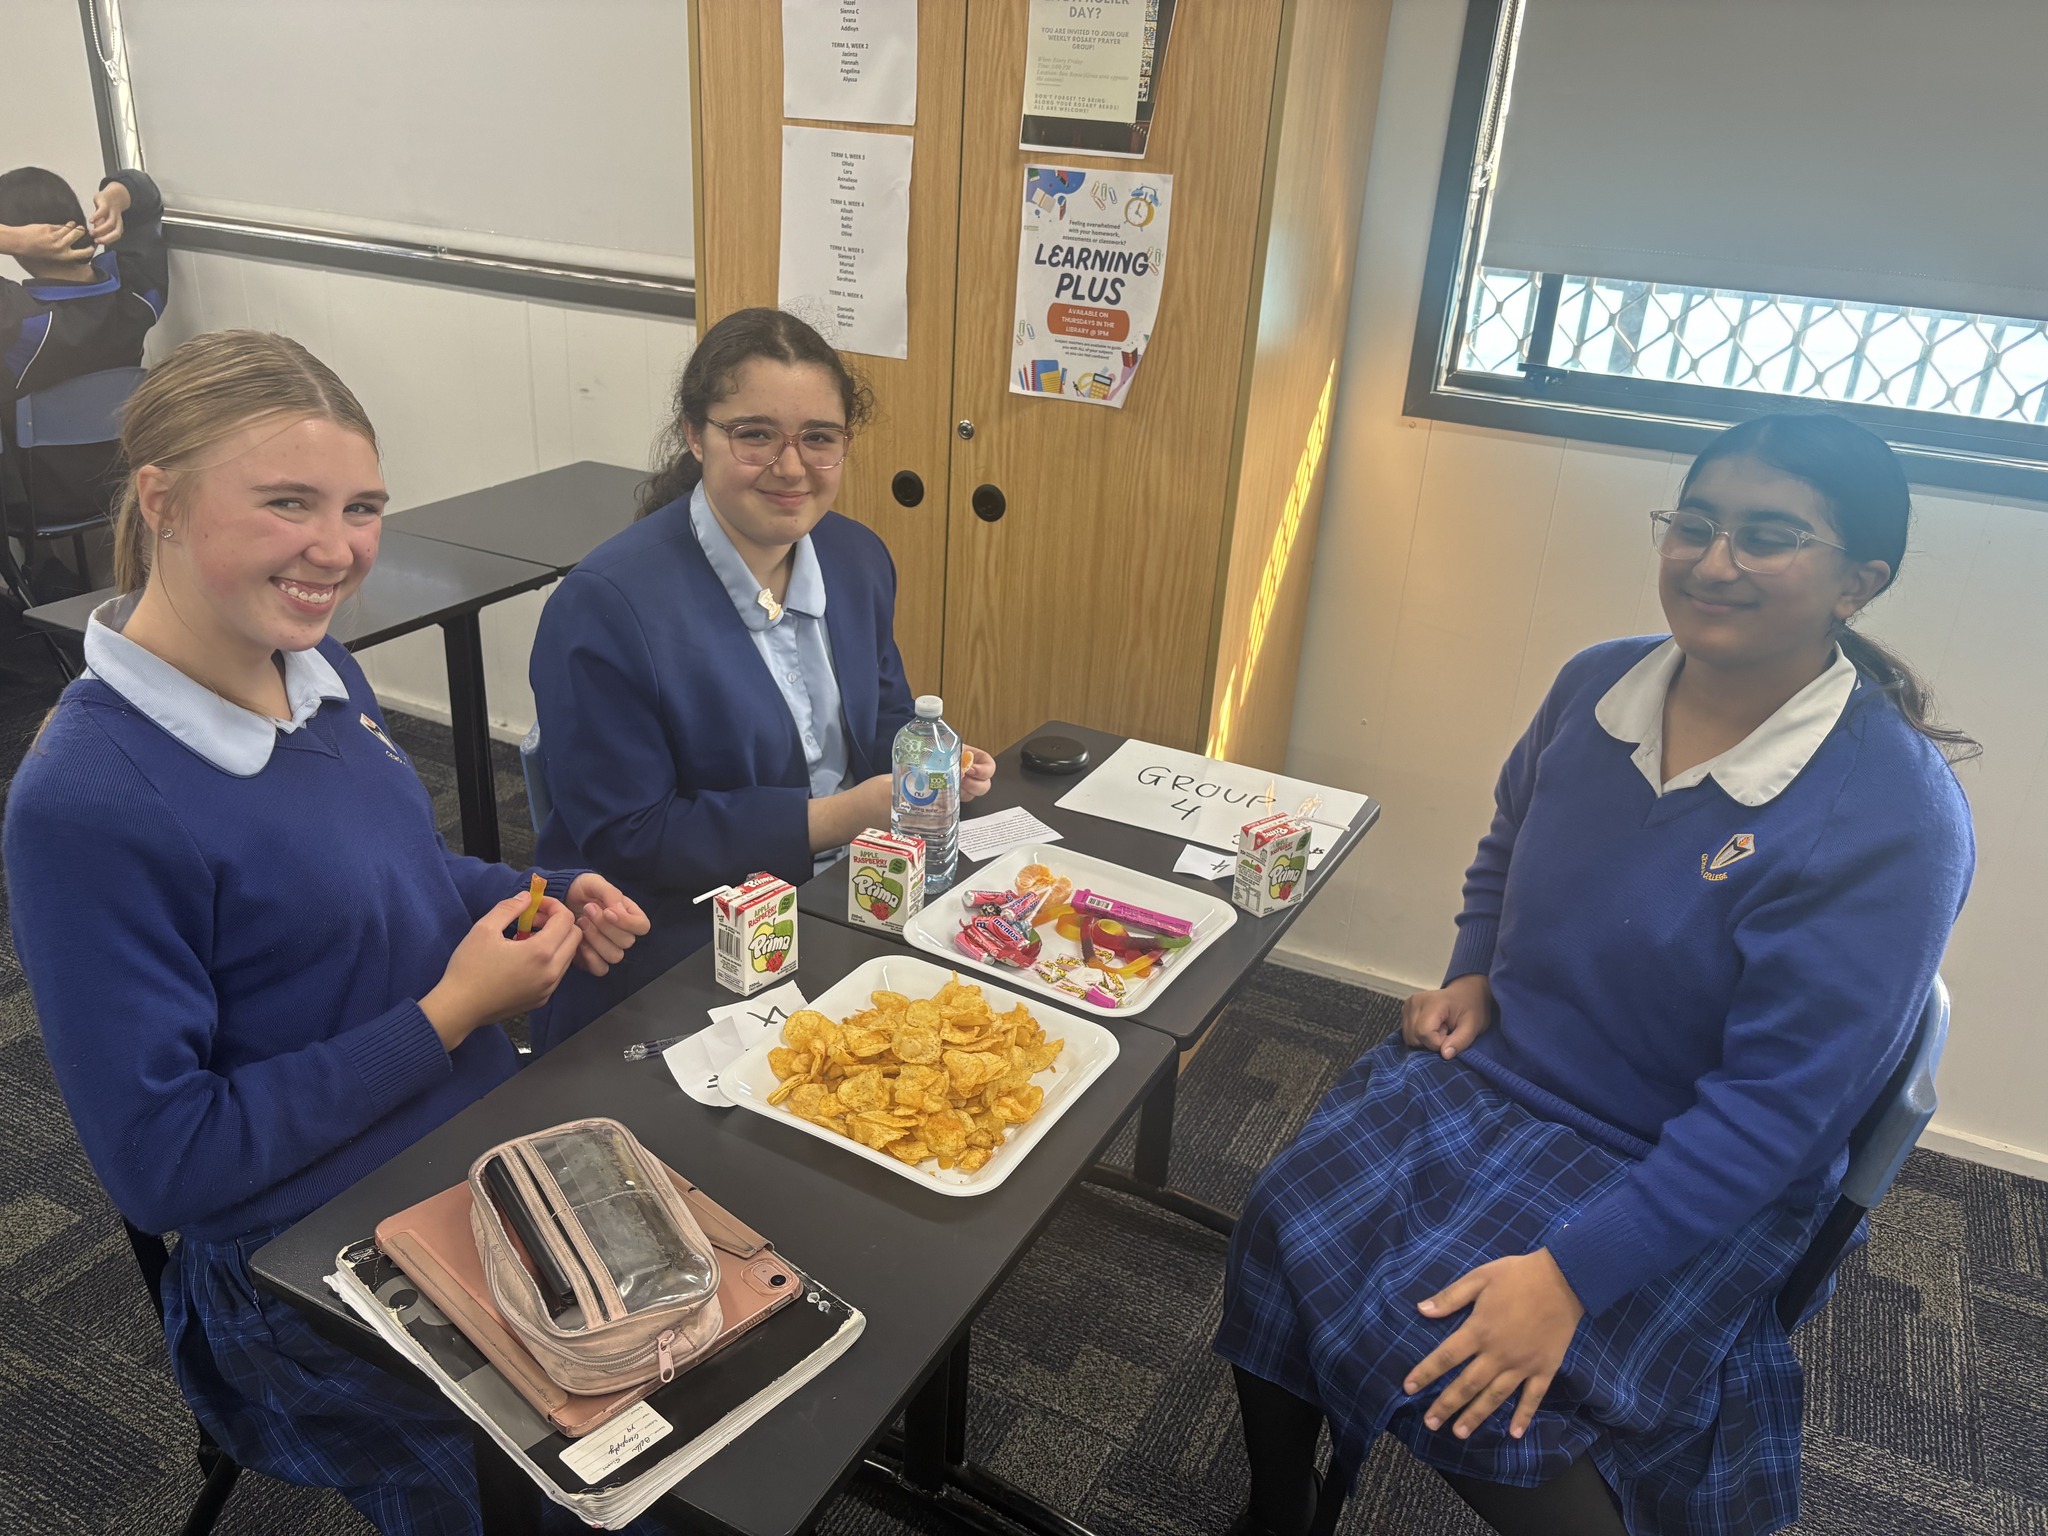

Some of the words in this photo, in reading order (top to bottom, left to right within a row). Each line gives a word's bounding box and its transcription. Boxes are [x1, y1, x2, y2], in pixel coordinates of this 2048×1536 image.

[1069, 6, 1102, 19] DAY?
[1092, 230, 1120, 238] homework,
[1035, 244, 1149, 276] LEARNING
[1055, 273, 1125, 305] PLUS
[1062, 316, 1095, 326] THURSDAYS
[1068, 309, 1097, 317] AVAILABLE
[1066, 326, 1089, 334] LIBRARY
[1137, 766, 1277, 809] GROUP
[1170, 798, 1202, 821] 4
[1270, 842, 1293, 856] RASPBERRY
[853, 856, 887, 865] RASPBERRY
[744, 876, 774, 887] Prima
[1268, 864, 1301, 887] Prima
[852, 875, 899, 909] Prima
[748, 904, 777, 928] RASPBERRY
[754, 902, 770, 917] APPLE
[993, 917, 1020, 942] mentos
[748, 933, 792, 960] Prima
